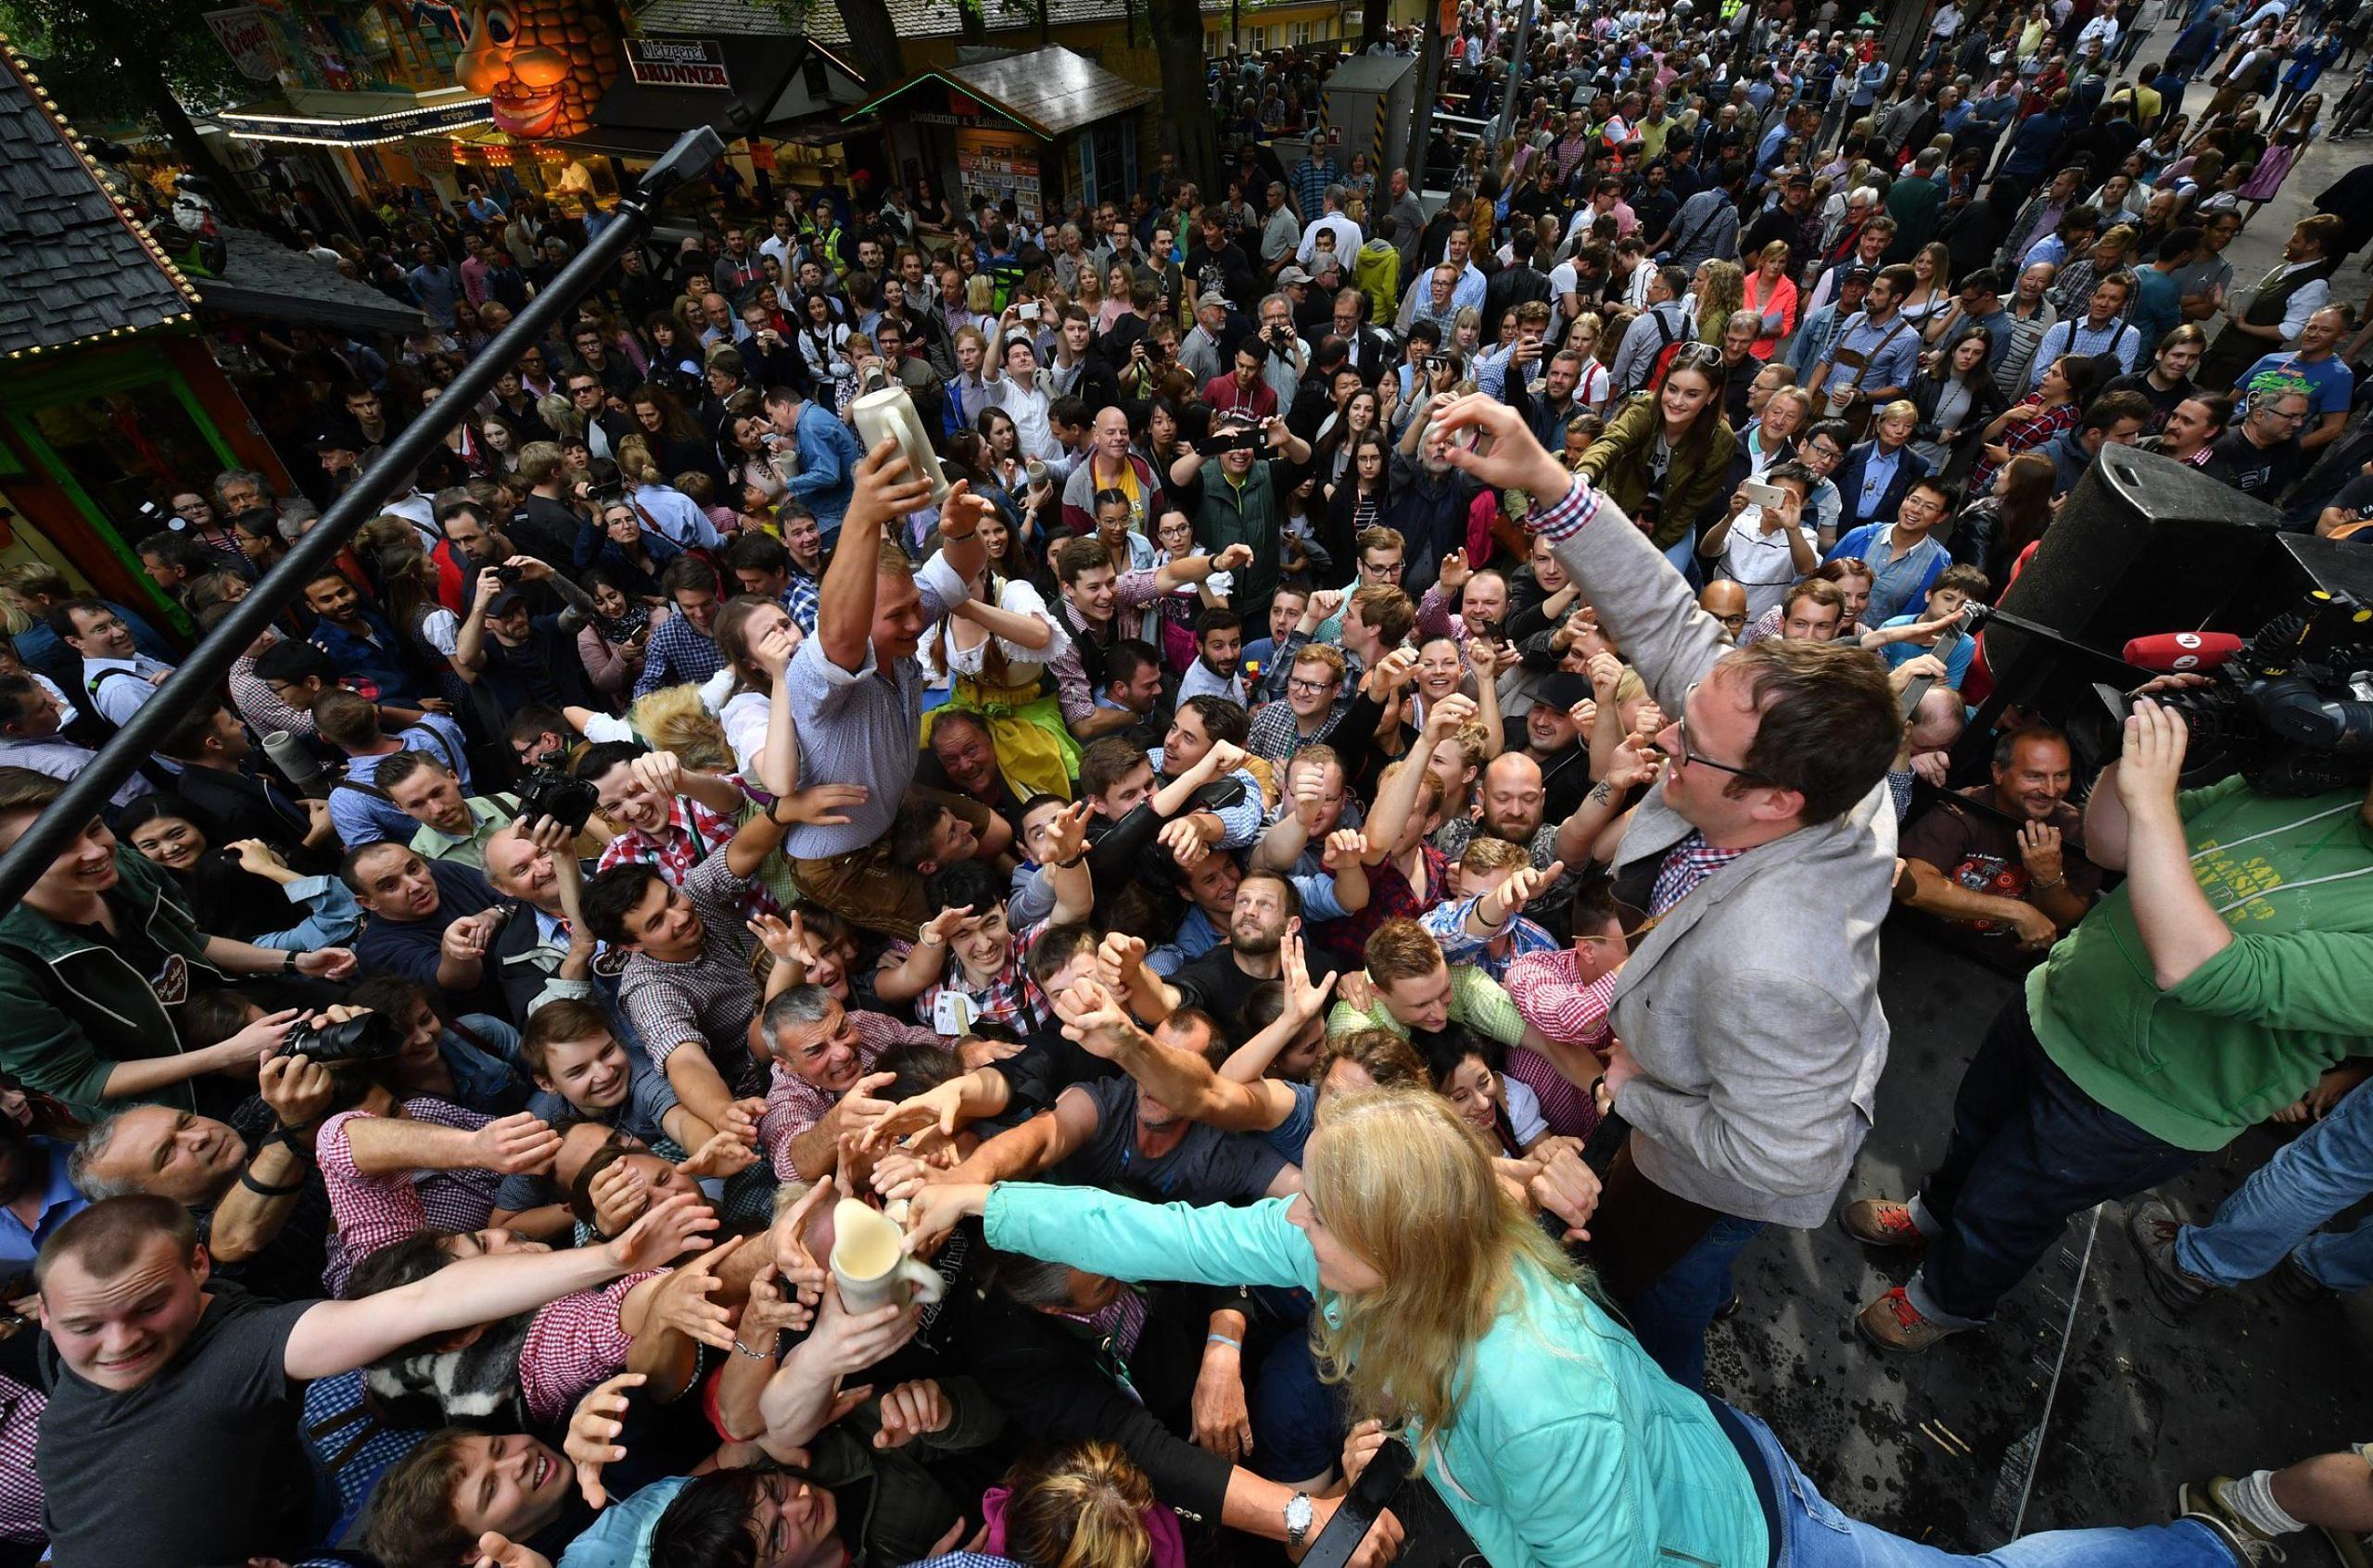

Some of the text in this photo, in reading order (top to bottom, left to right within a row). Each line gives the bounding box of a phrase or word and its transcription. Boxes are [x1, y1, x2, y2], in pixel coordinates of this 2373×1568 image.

[639, 40, 707, 66] Metzgerei
[635, 64, 729, 85] BRUNNER
[2242, 856, 2283, 891] SAN
